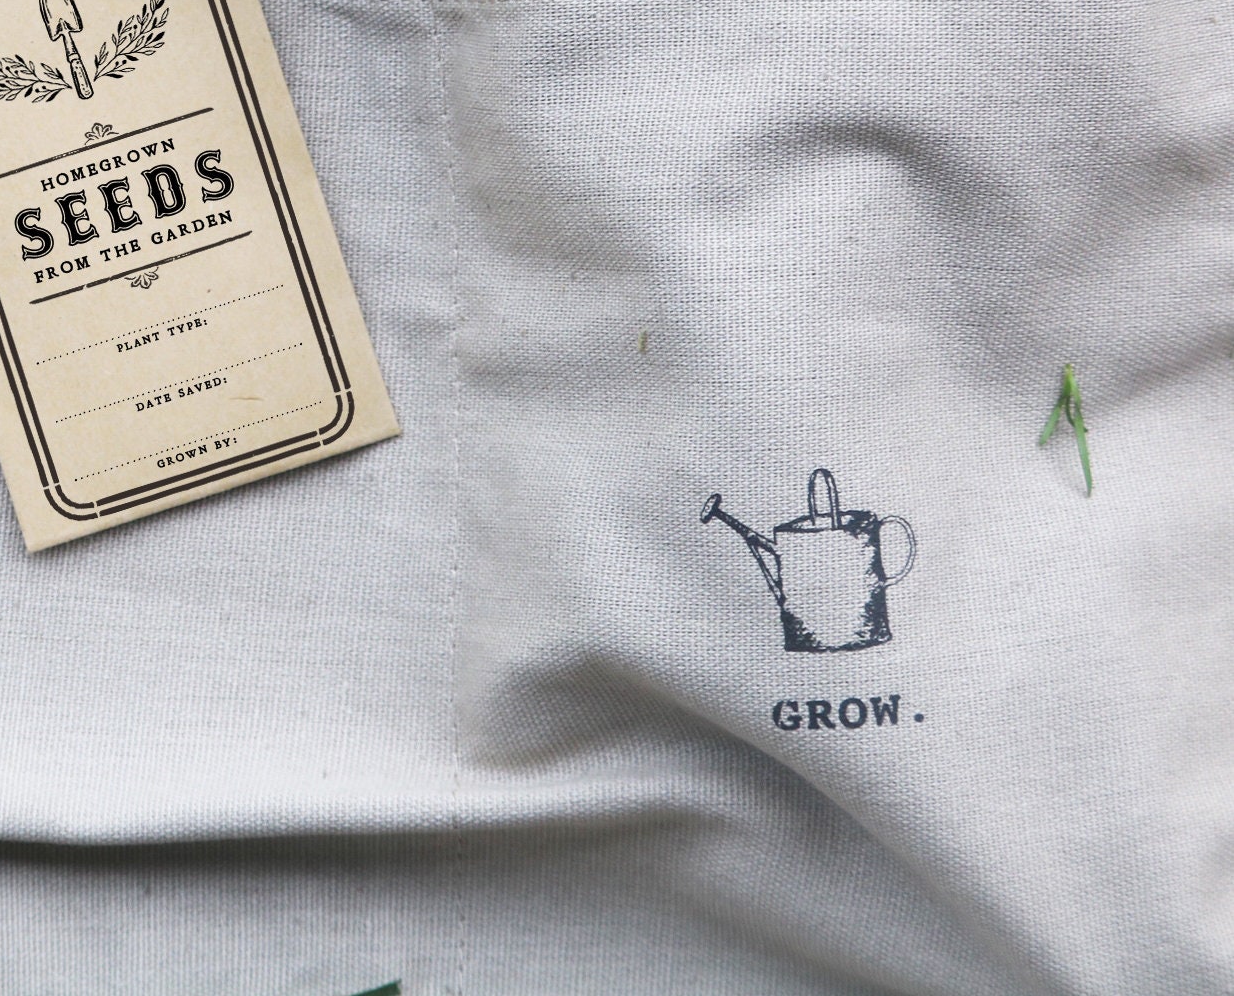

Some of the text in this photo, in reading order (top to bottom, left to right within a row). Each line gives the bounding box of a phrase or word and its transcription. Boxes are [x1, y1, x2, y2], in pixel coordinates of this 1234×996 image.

[41, 138, 175, 191] HOMEGROWN
[14, 149, 235, 261] SEEDS
[34, 210, 233, 284] FROM THE GARDEN
[116, 318, 208, 353] PLANT TYPE:
[136, 377, 228, 412] DATE SAVED:
[157, 437, 238, 469] GROWN BY:
[772, 694, 924, 731] GROW.
